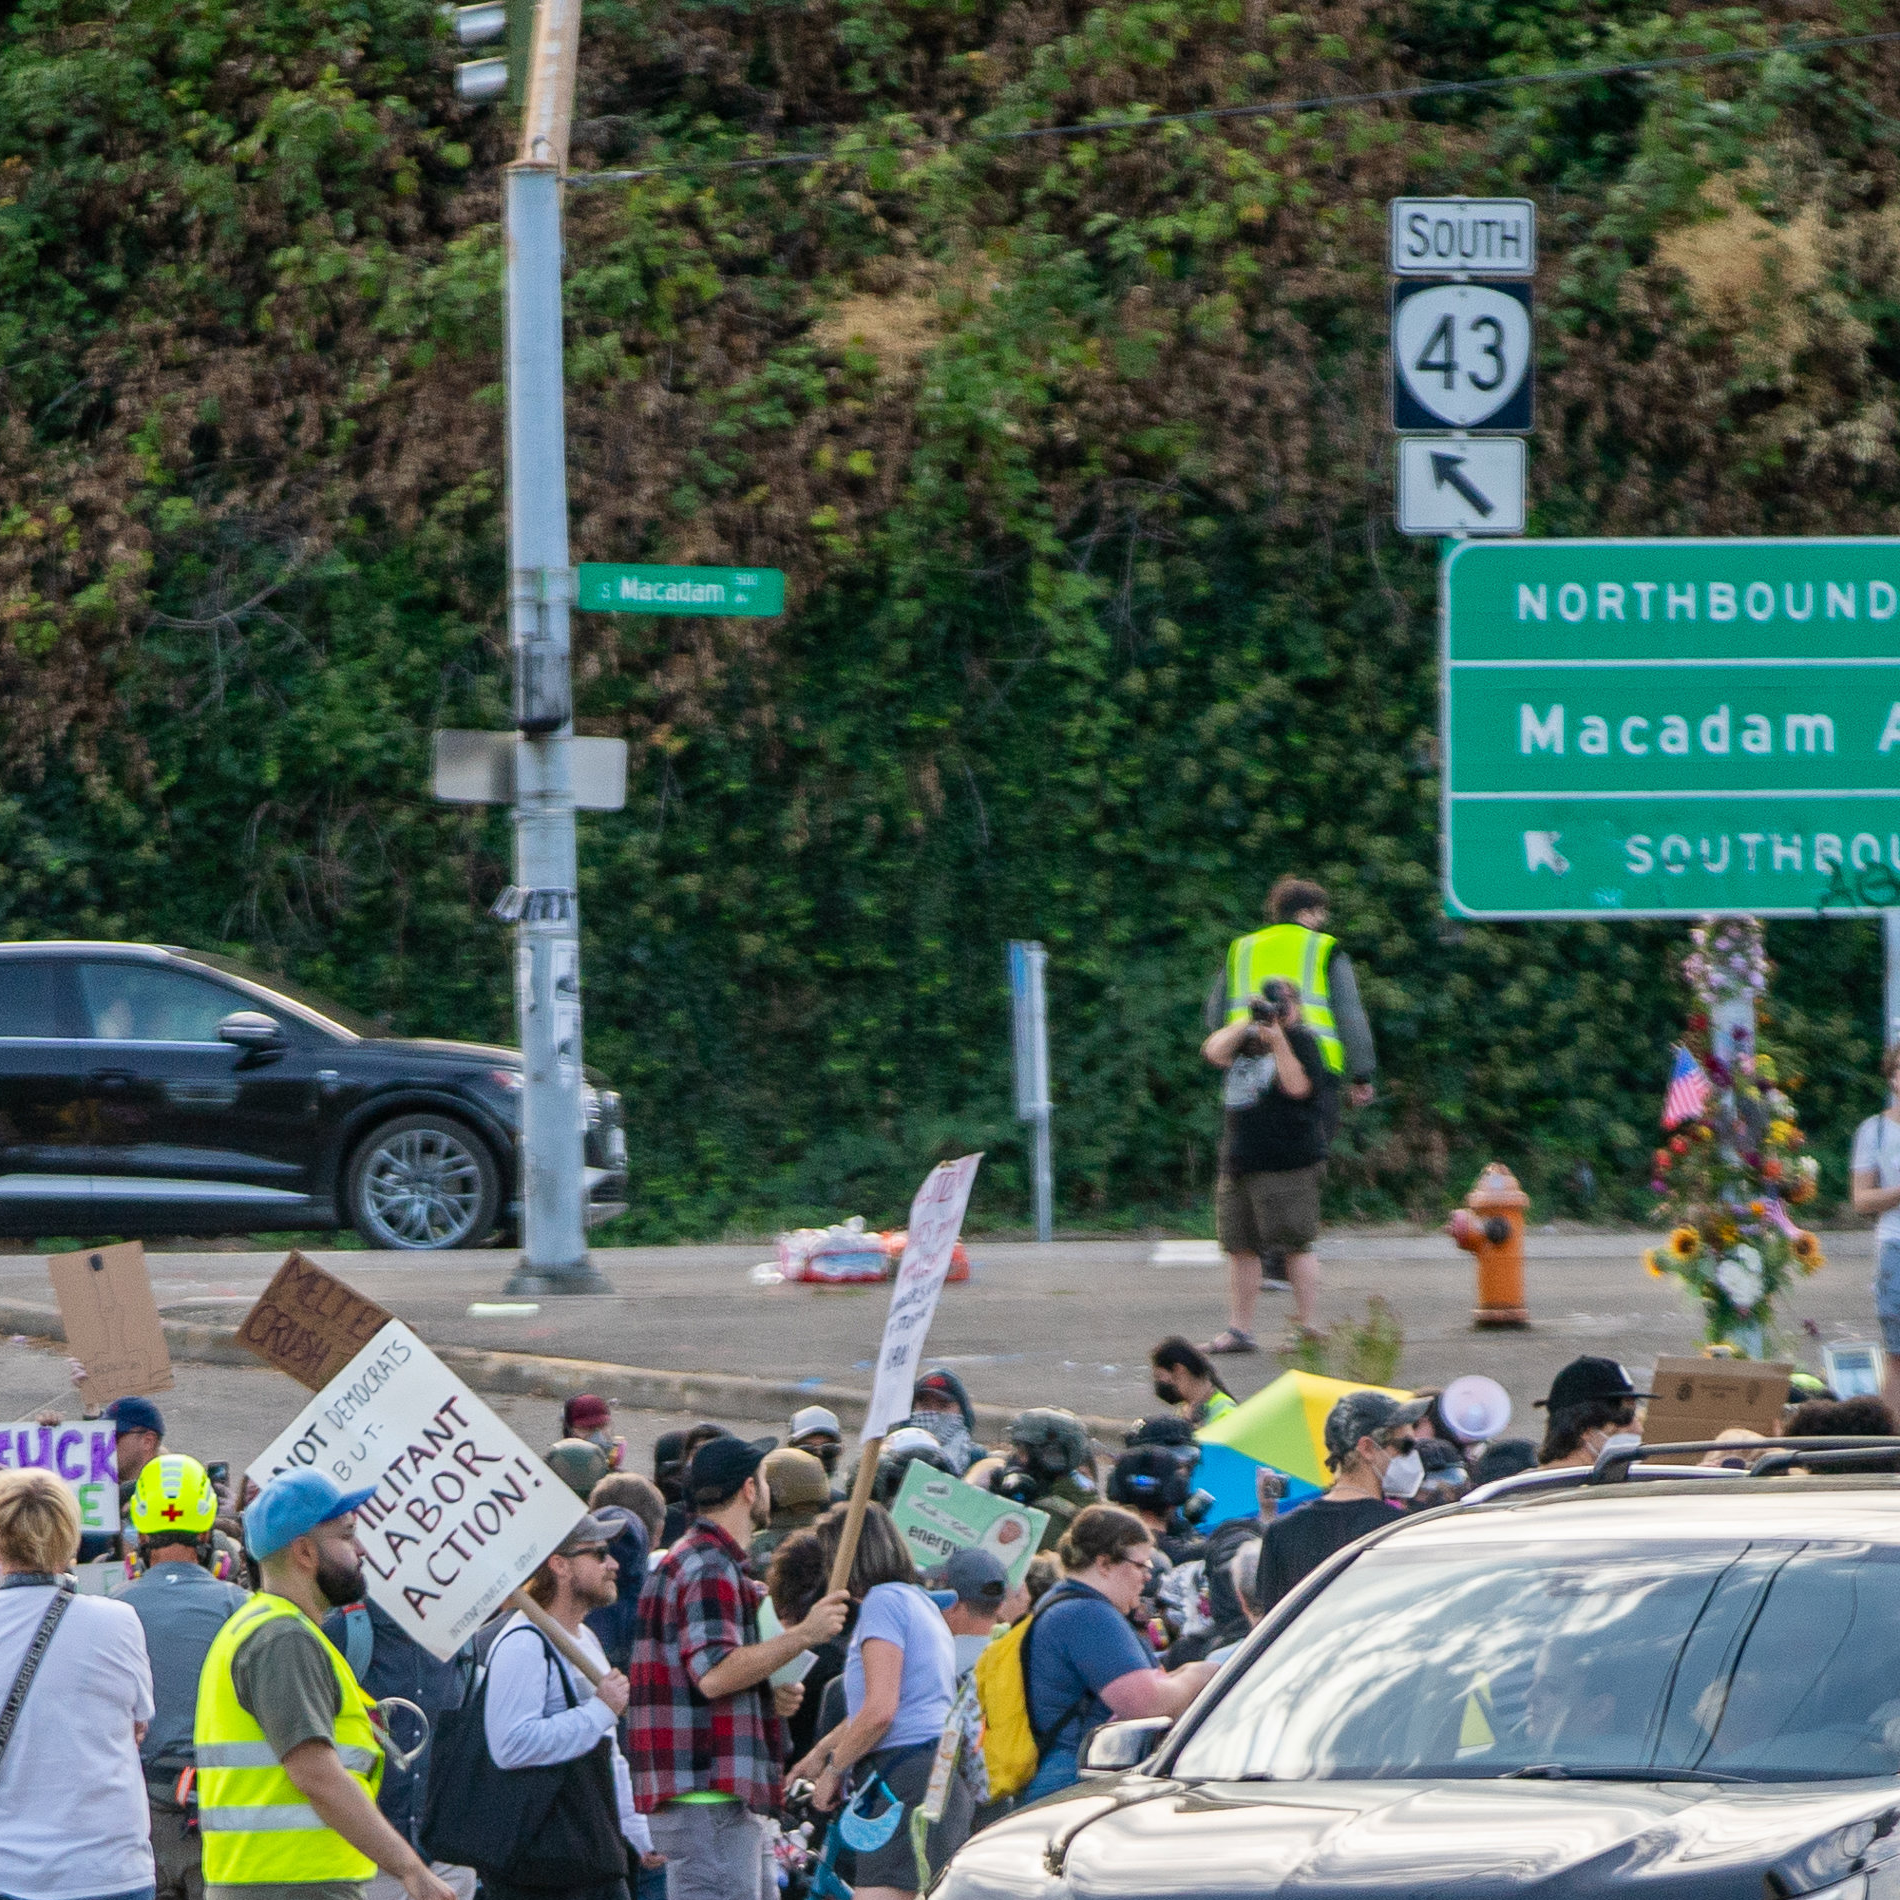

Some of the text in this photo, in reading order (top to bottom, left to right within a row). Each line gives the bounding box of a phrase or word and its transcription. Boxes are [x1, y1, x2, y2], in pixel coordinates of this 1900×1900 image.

[1406, 212, 1522, 262] SOUTH
[1414, 313, 1506, 392] 43
[619, 575, 726, 603] Macadam
[1517, 580, 1899, 622] NORTHBOUND
[1519, 701, 1837, 757] Macadam
[246, 1304, 330, 1368] CRUSH
[324, 1337, 413, 1431] DEMOCRATS
[363, 1438, 506, 1580] LABOR
[402, 1456, 543, 1621] ACTION!
[41, 1597, 68, 1636] PARIS
